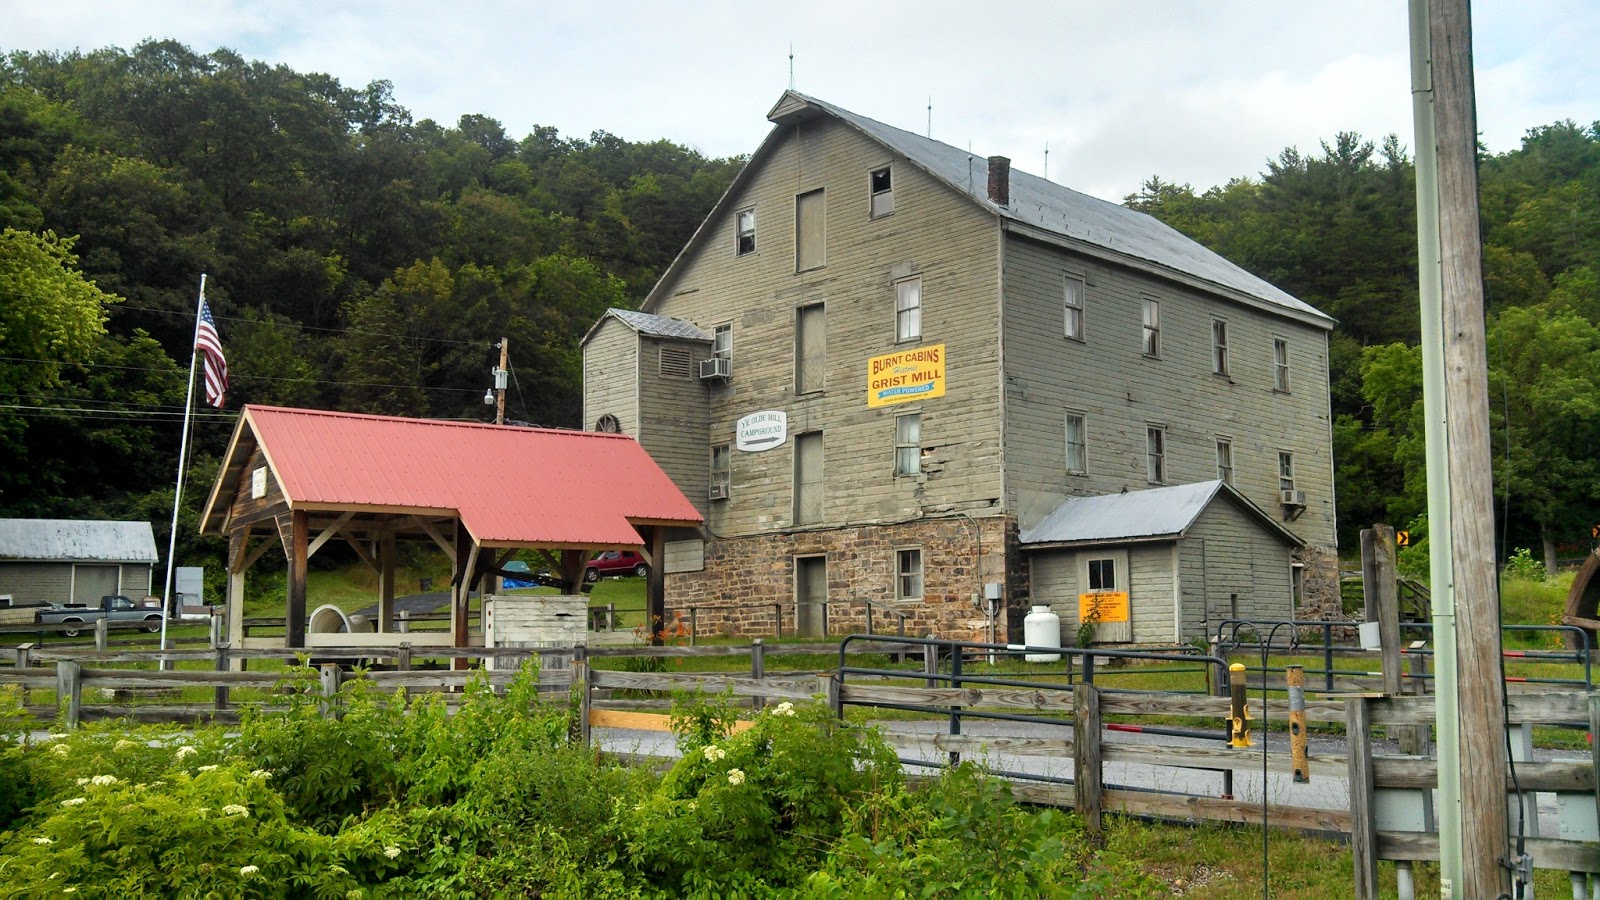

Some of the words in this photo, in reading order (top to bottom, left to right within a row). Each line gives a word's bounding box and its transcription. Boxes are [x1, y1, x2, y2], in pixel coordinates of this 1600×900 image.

[873, 355, 903, 375] BURNT
[905, 349, 939, 363] CABINS
[872, 375, 908, 390] GRIST
[912, 369, 941, 383] MILL
[882, 387, 901, 397] WATER
[901, 384, 930, 394] POWERED
[741, 419, 750, 429] YE
[751, 414, 767, 424] OLDE
[768, 413, 782, 423] MILL
[740, 425, 782, 438] CAMPGROUND
